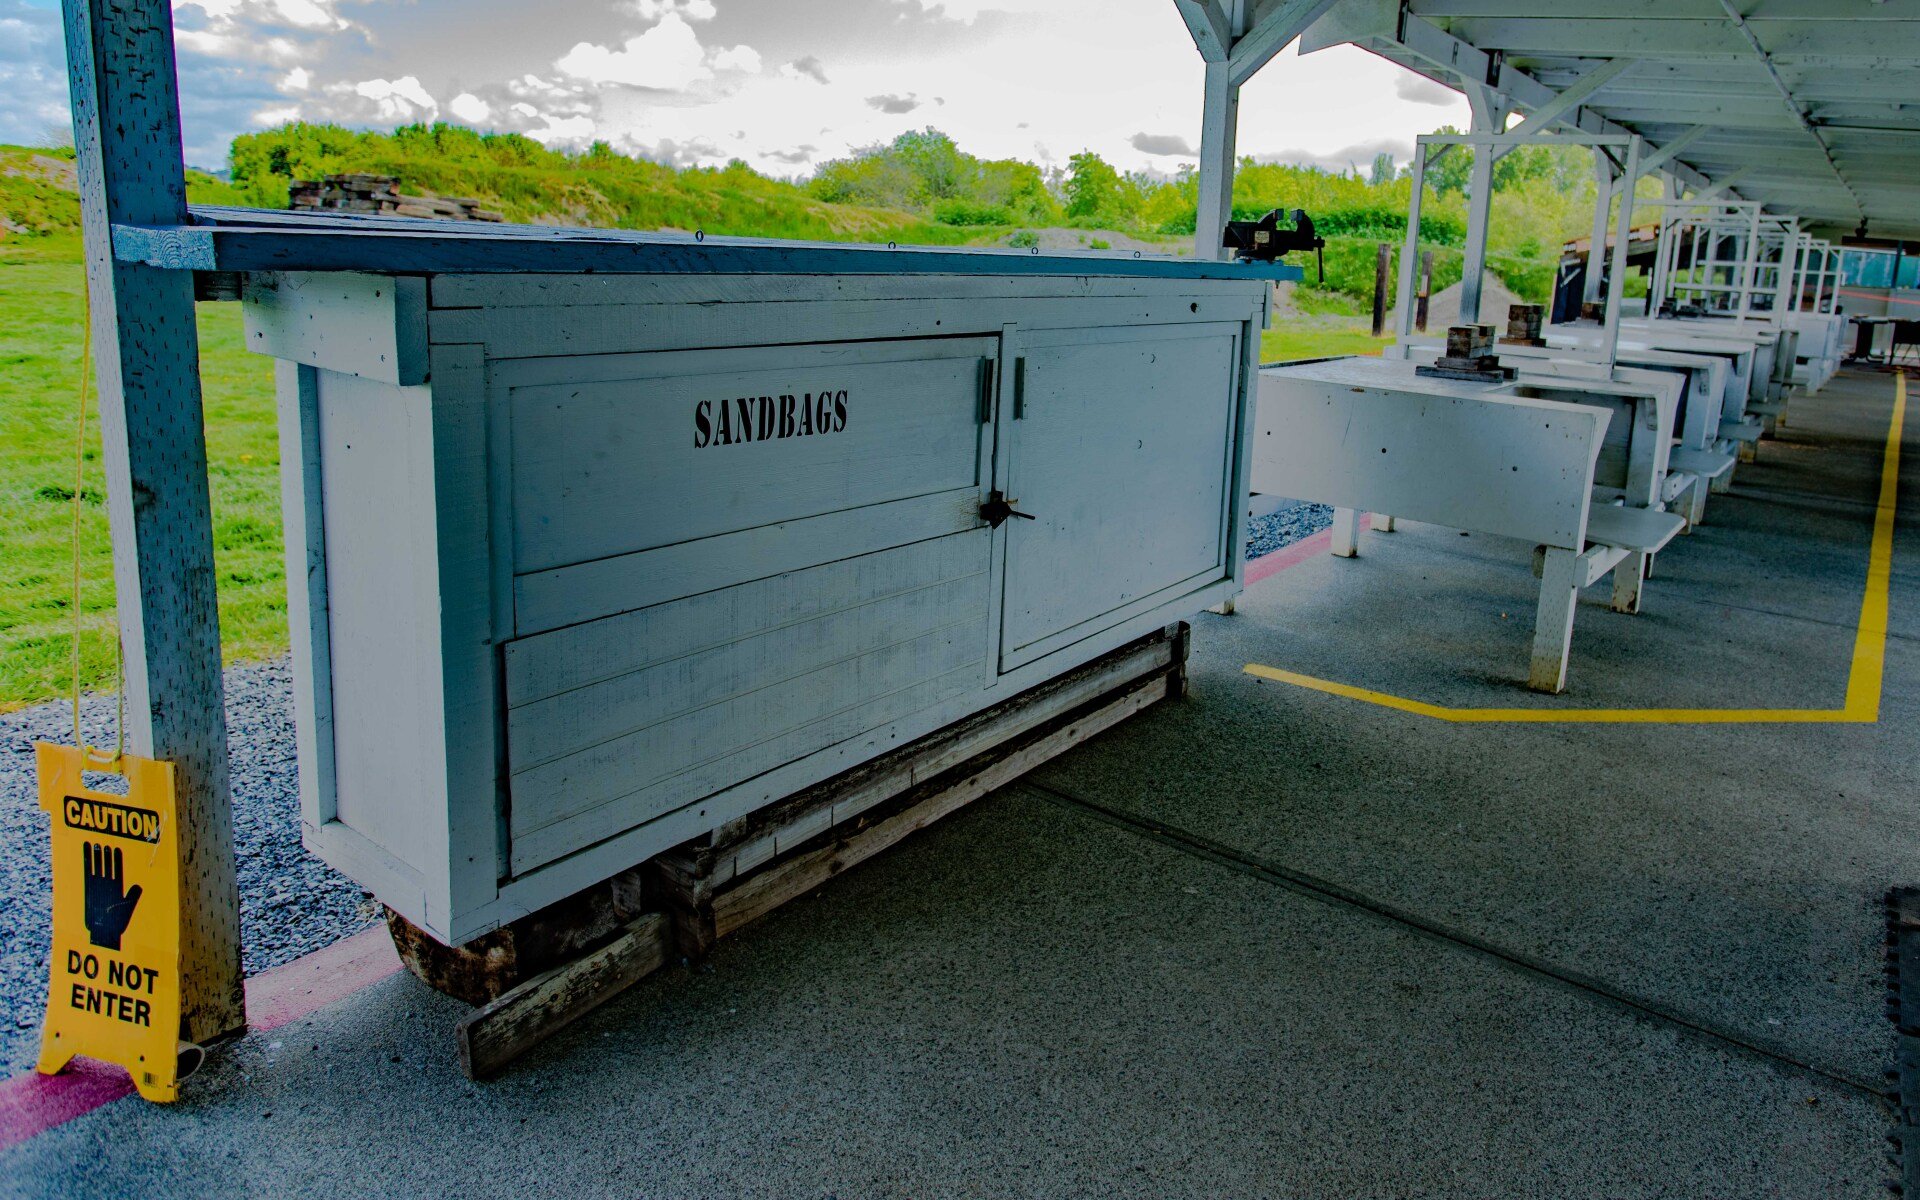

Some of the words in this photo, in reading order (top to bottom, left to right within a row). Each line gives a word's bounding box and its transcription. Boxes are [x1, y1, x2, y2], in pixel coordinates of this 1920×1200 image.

[695, 390, 848, 448] SANDBAGS
[66, 800, 158, 840] CAUTION
[67, 949, 99, 979] DO
[109, 960, 159, 995] NOT
[71, 983, 150, 1027] ENTER
